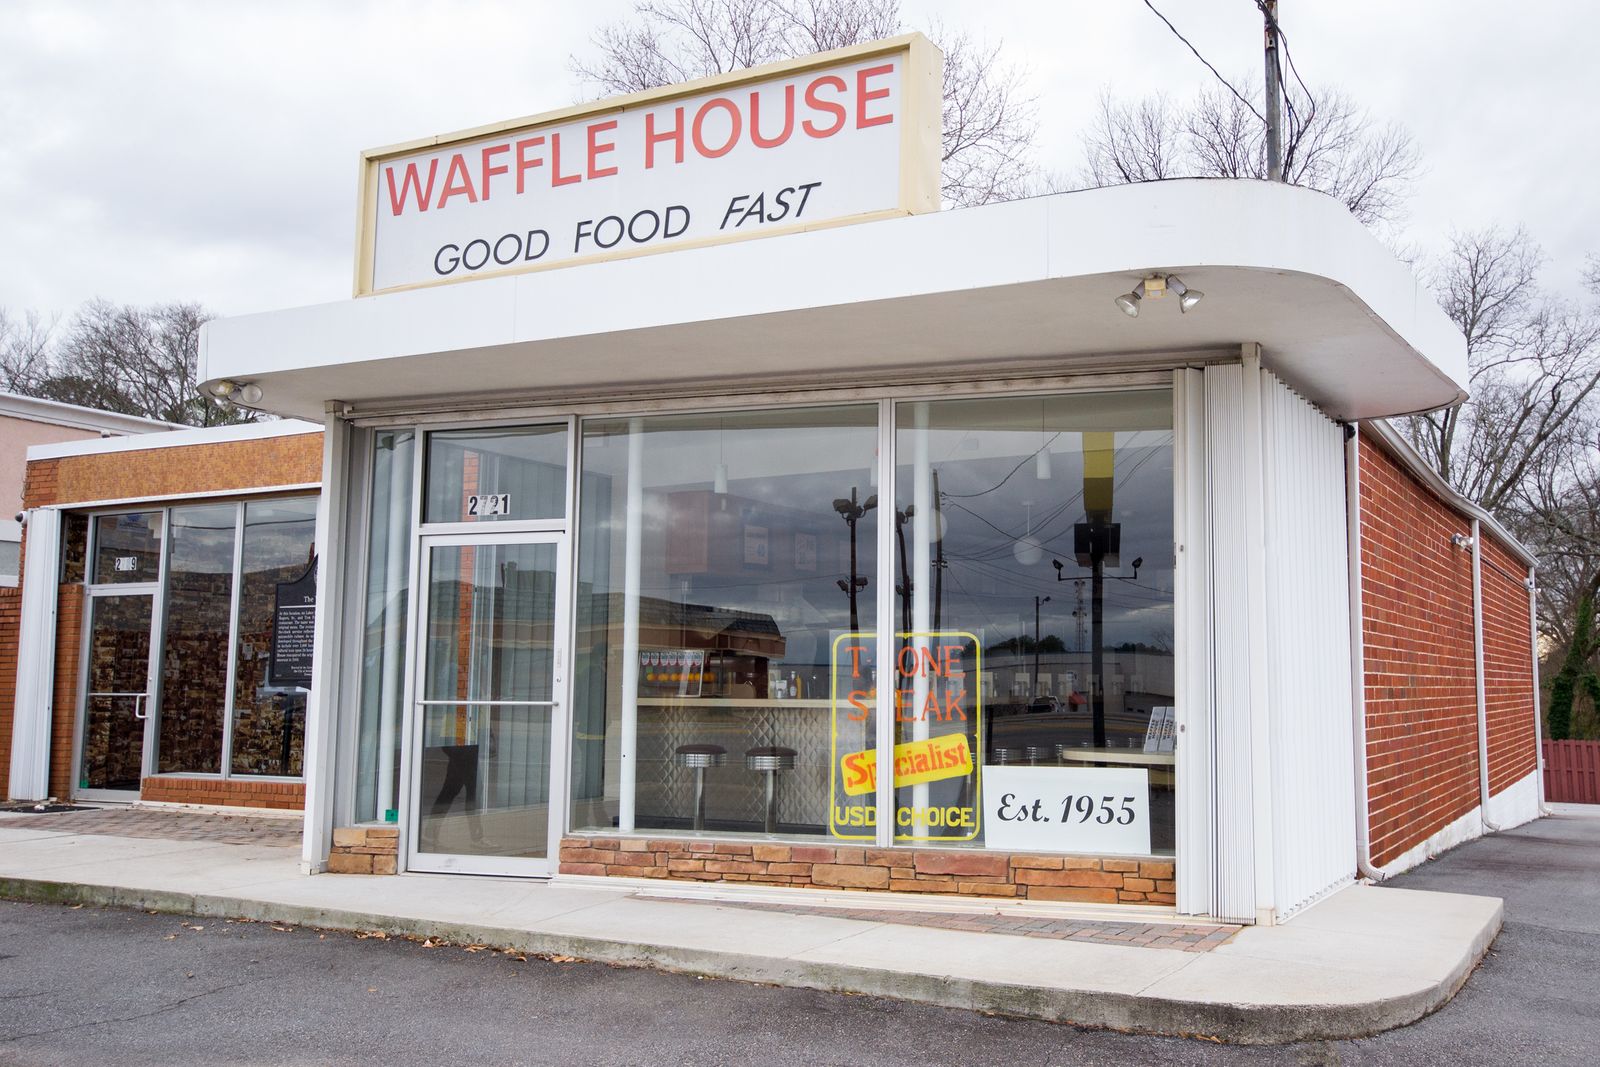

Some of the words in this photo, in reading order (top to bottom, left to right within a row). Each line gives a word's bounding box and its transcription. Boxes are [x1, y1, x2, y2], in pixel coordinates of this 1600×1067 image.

[385, 120, 618, 216] WAFFLE
[644, 64, 894, 169] HOUSE
[433, 229, 549, 275] GOOD
[573, 205, 691, 253] FOOD
[719, 182, 822, 230] FAST
[844, 645, 966, 678] T-ONE
[847, 688, 967, 722] SEAK
[845, 742, 967, 790] Spcialist
[835, 806, 878, 828] USD
[897, 806, 975, 828] CHOICE
[997, 793, 1049, 822] Est.
[1061, 795, 1136, 825] 1955
